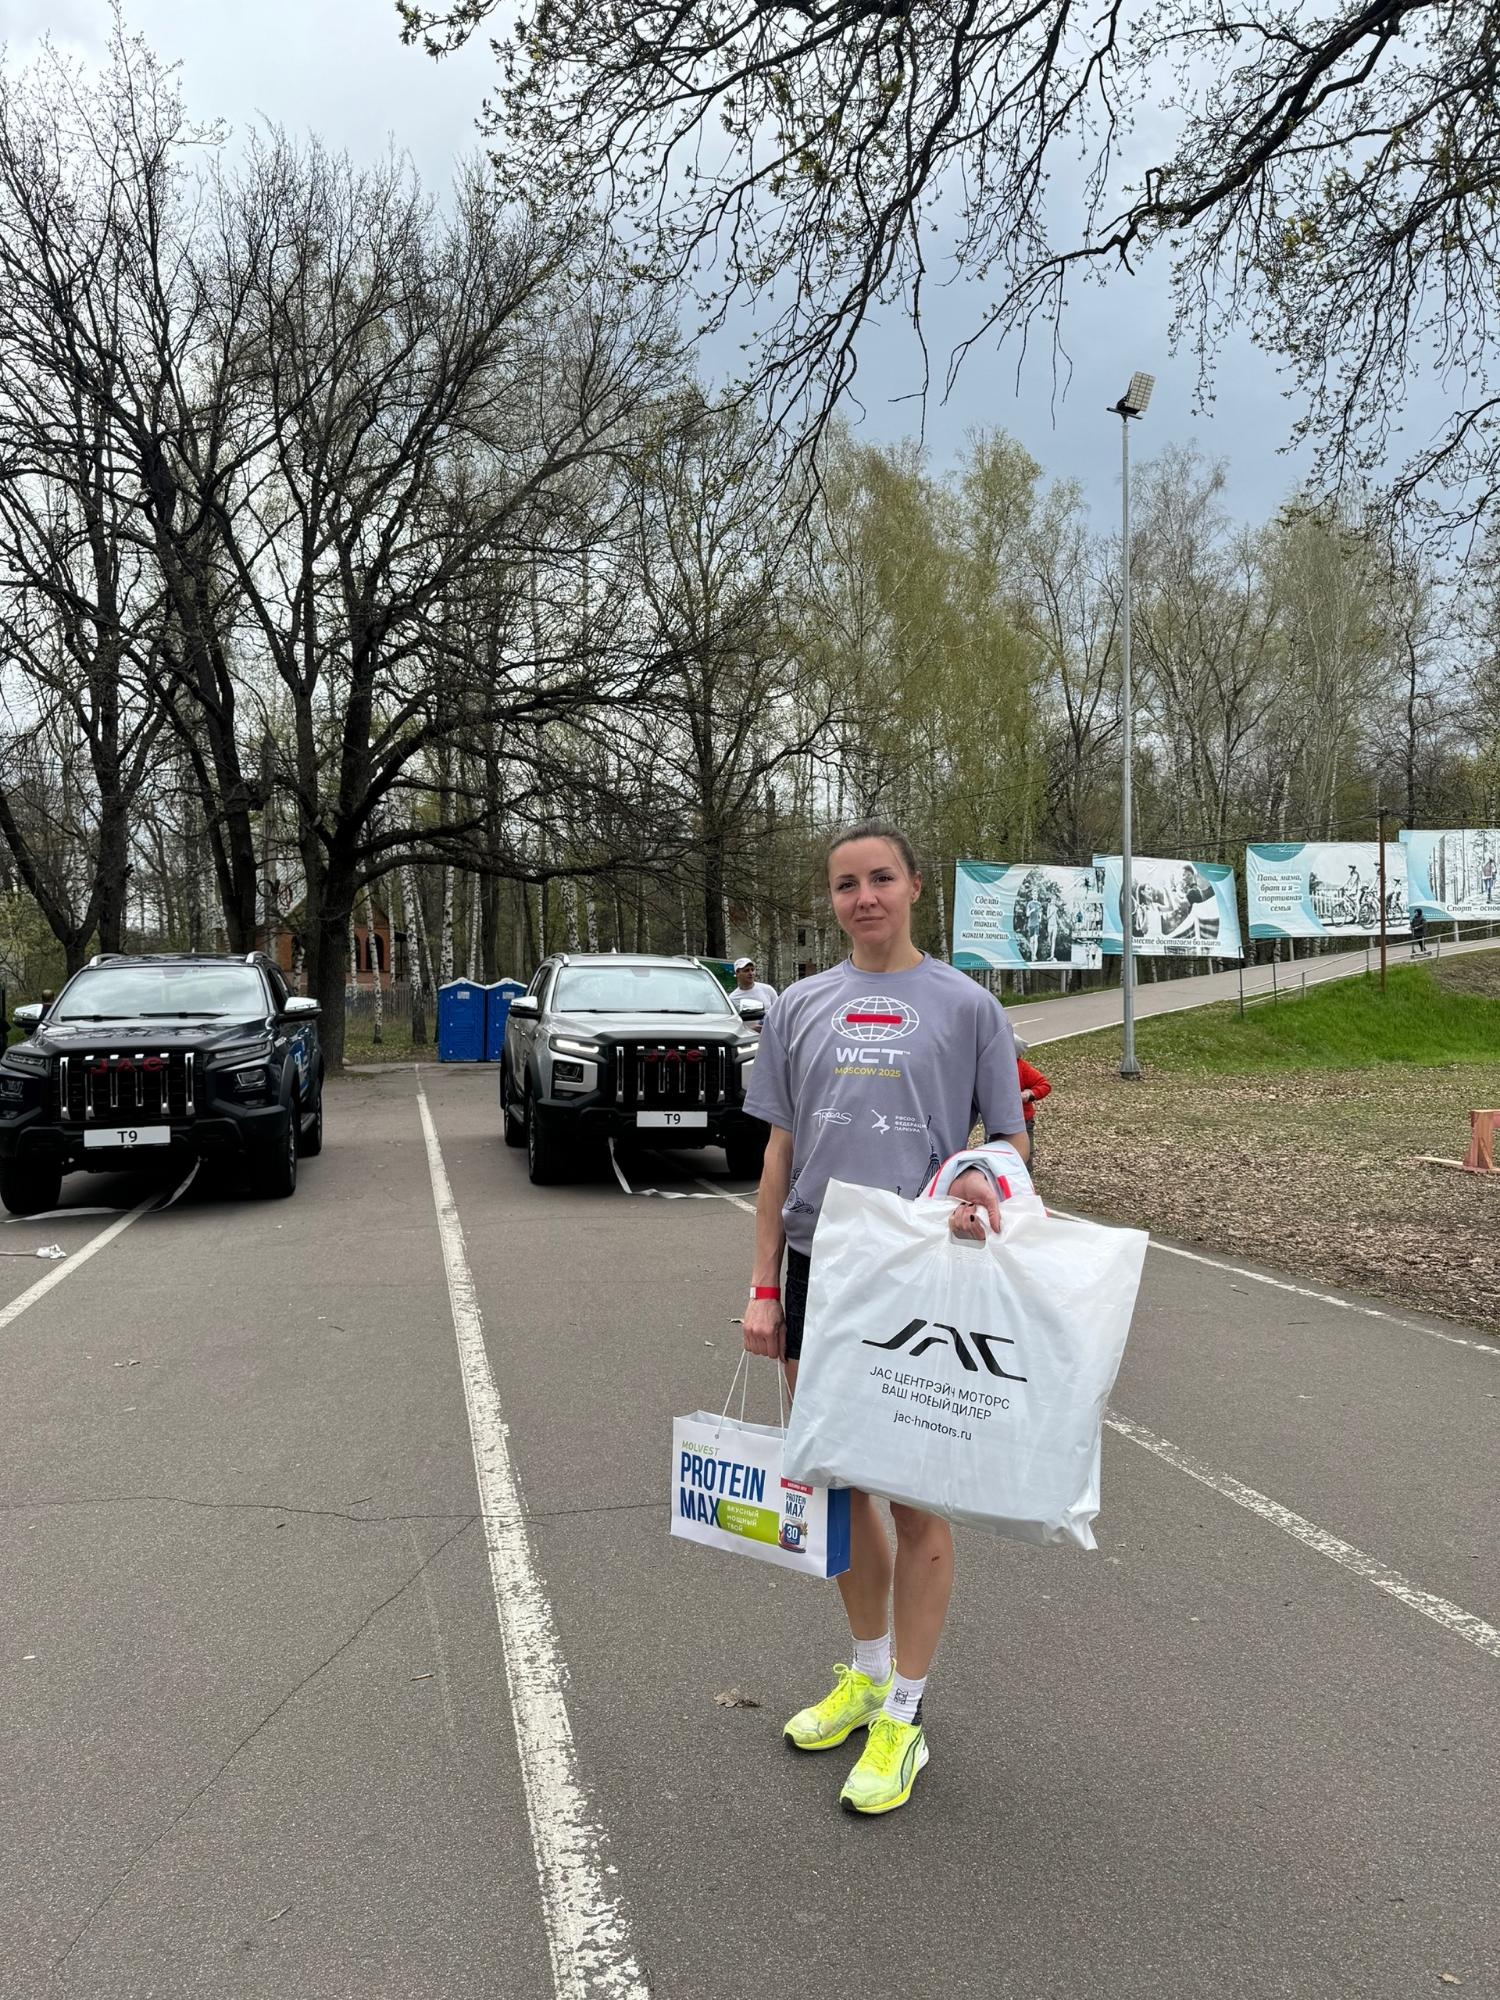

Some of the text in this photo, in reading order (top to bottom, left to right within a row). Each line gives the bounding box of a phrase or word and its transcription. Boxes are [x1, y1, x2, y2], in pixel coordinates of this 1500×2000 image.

[1446, 904, 1472, 913] Спорт
[836, 1047, 904, 1065] WCT
[90, 1057, 164, 1074] JAC
[833, 1066, 902, 1078] MOSCOW 2025
[664, 1113, 681, 1125] T9
[116, 1130, 138, 1143] T9
[861, 1318, 1028, 1383] JAC
[870, 1366, 893, 1380] JAC
[958, 1389, 1010, 1410] МОТОРС
[881, 1383, 908, 1399] ВАШ
[951, 1402, 992, 1420] ДИЛЕР
[681, 1440, 720, 1457] MOLVEST
[681, 1451, 766, 1503] PROTEIN
[680, 1486, 722, 1528] MAX
[785, 1492, 807, 1506] PROTEIN
[785, 1501, 805, 1518] MAX
[786, 1526, 798, 1540] 30
